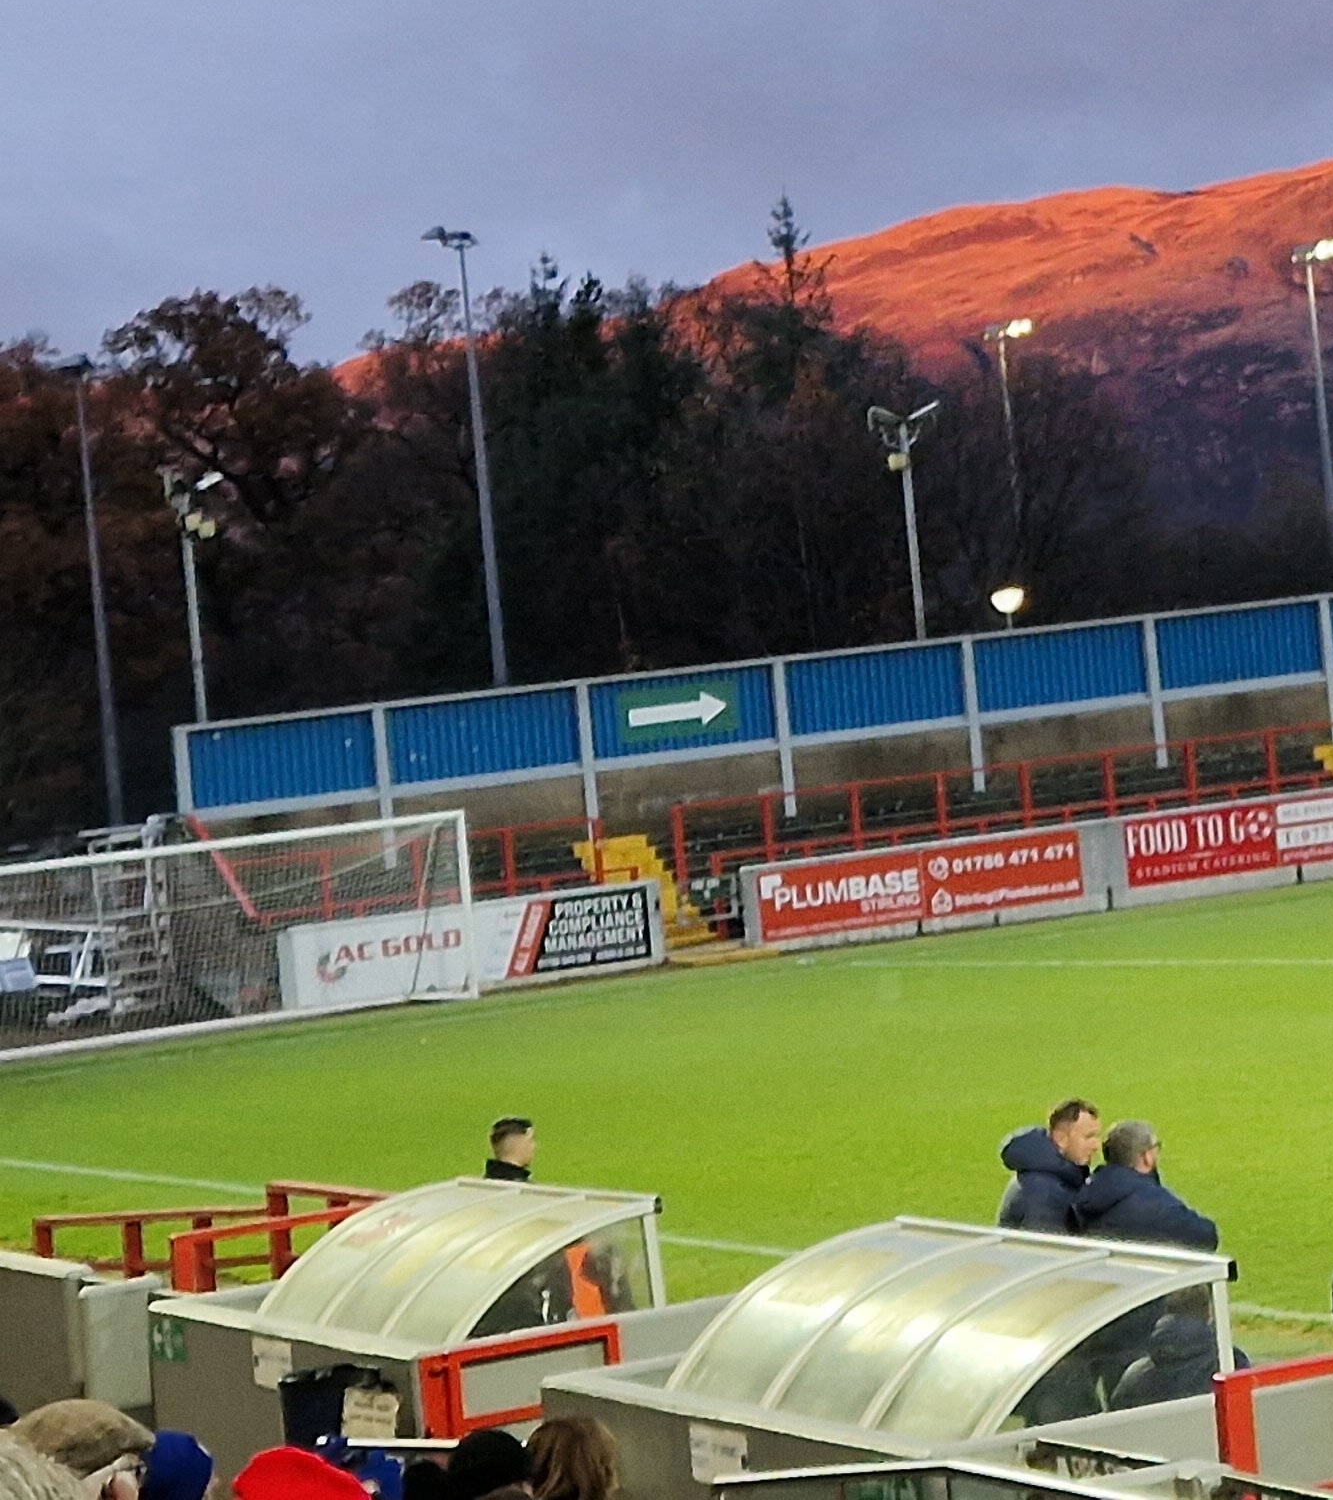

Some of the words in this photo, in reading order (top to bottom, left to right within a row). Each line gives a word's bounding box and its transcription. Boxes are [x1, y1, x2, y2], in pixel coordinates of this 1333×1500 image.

[1125, 818, 1189, 859] FOOD
[1190, 812, 1224, 850] TO
[1007, 847, 1039, 866] 471
[1043, 841, 1075, 861] 471
[1136, 860, 1198, 879] STADIUM
[1202, 850, 1271, 871] CATERING
[773, 867, 919, 912] PLUMBASE
[554, 894, 629, 920] PROPERTY
[548, 908, 645, 936] COMPLIANCE
[334, 941, 374, 964] AC
[381, 928, 462, 959] GOLD
[544, 925, 645, 953] MANAGEMENT
